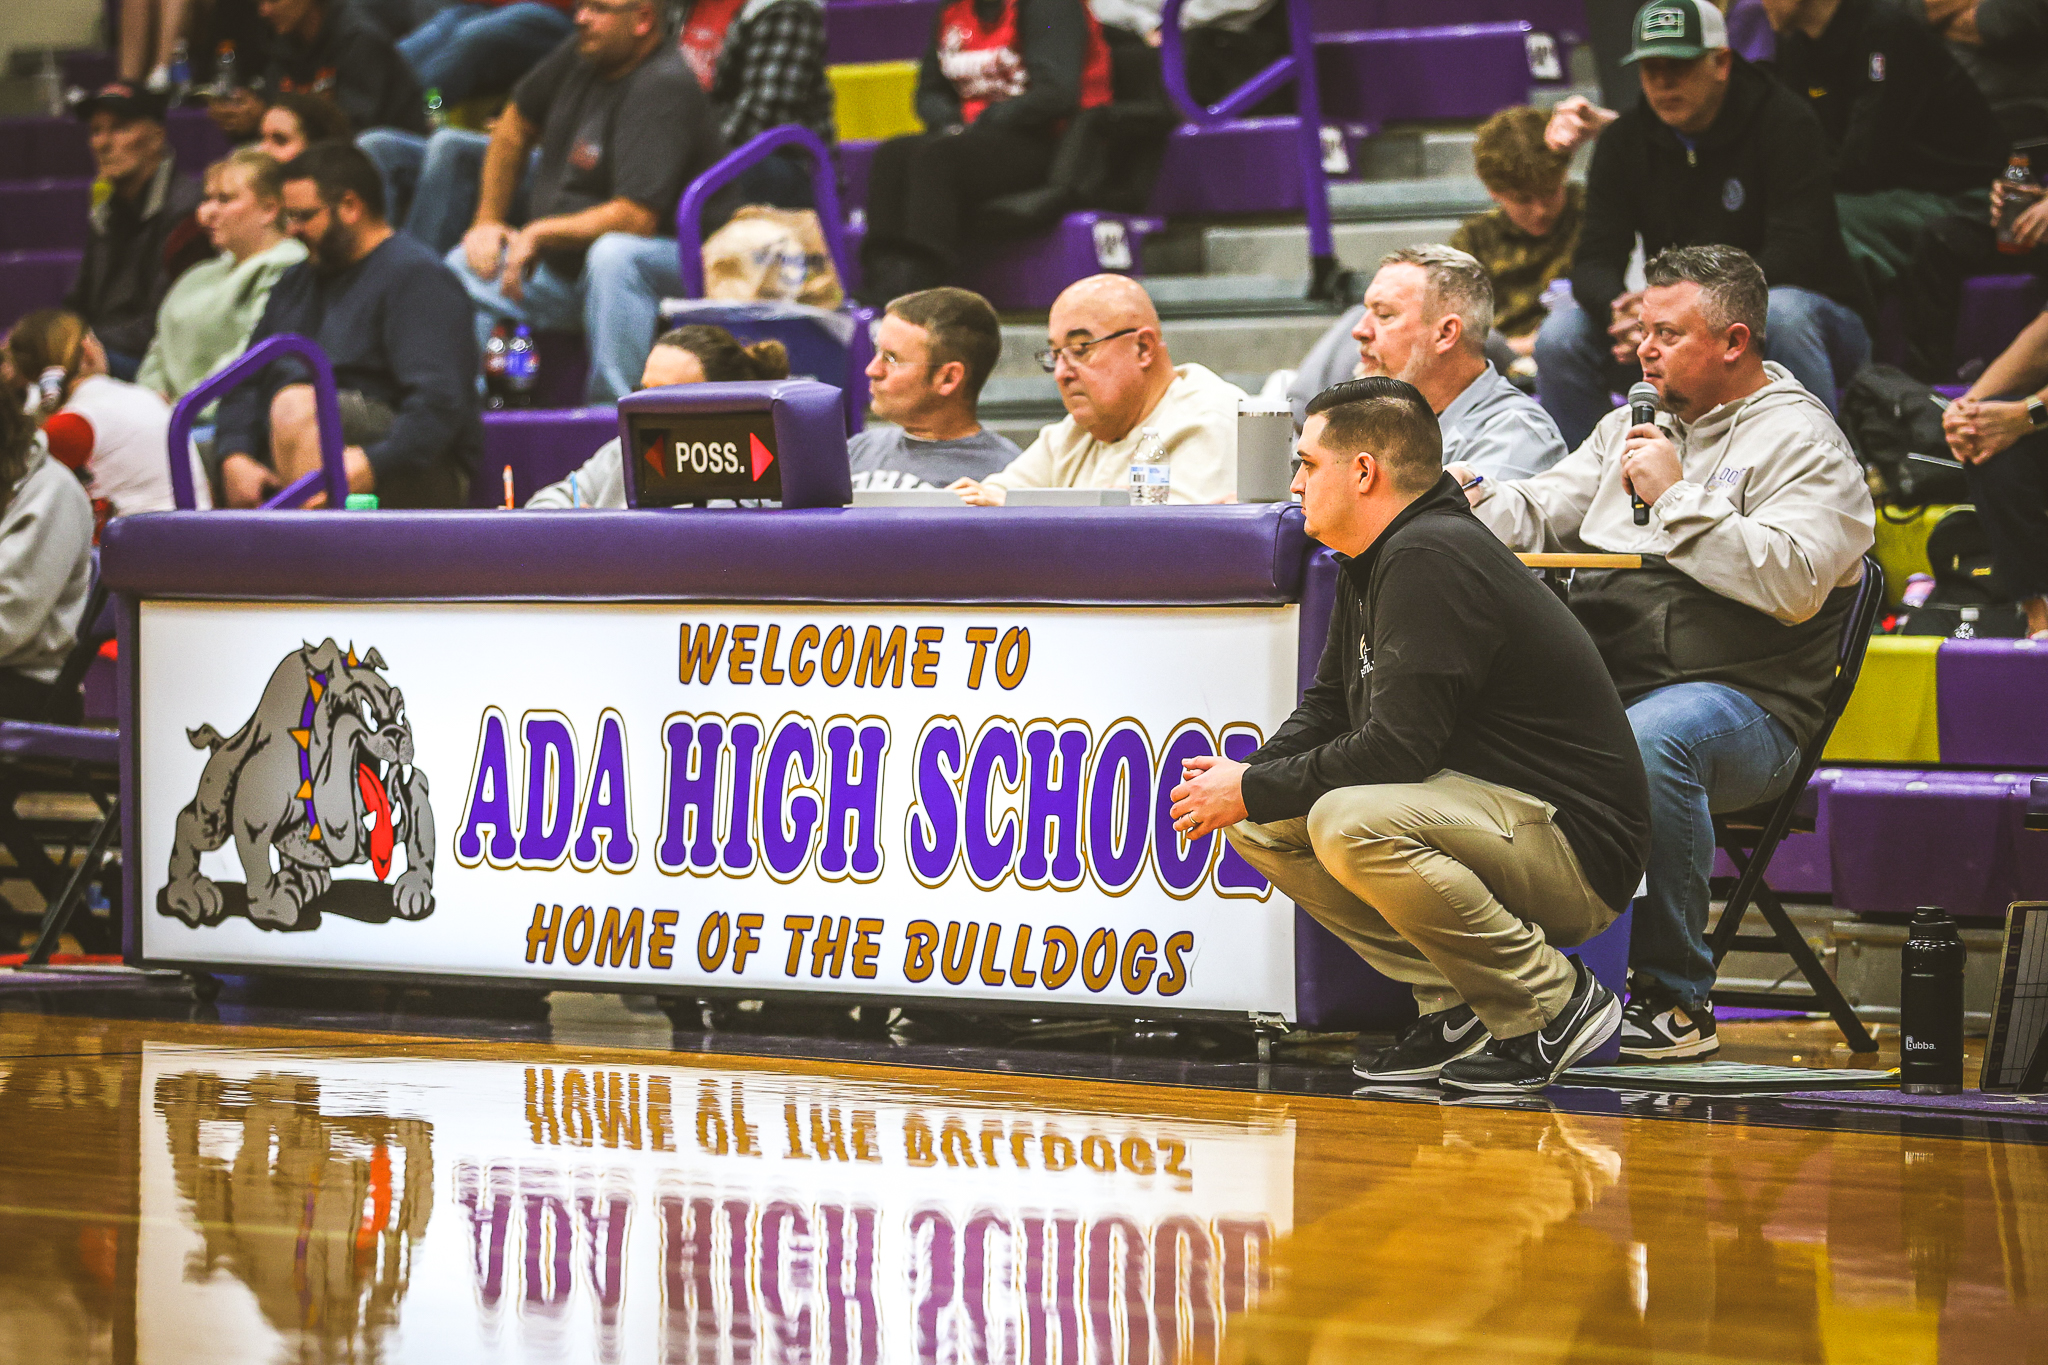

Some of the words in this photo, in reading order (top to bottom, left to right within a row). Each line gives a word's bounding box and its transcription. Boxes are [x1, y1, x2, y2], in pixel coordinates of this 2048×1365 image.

[675, 441, 745, 474] POSS.
[678, 623, 945, 690] WELCOME
[965, 626, 1031, 691] TO
[453, 705, 639, 874] ADA
[655, 711, 891, 884] HIGH
[525, 903, 680, 969] HOME
[697, 910, 764, 974] OF
[784, 915, 884, 979] THE
[903, 919, 1194, 996] BULLDOGS
